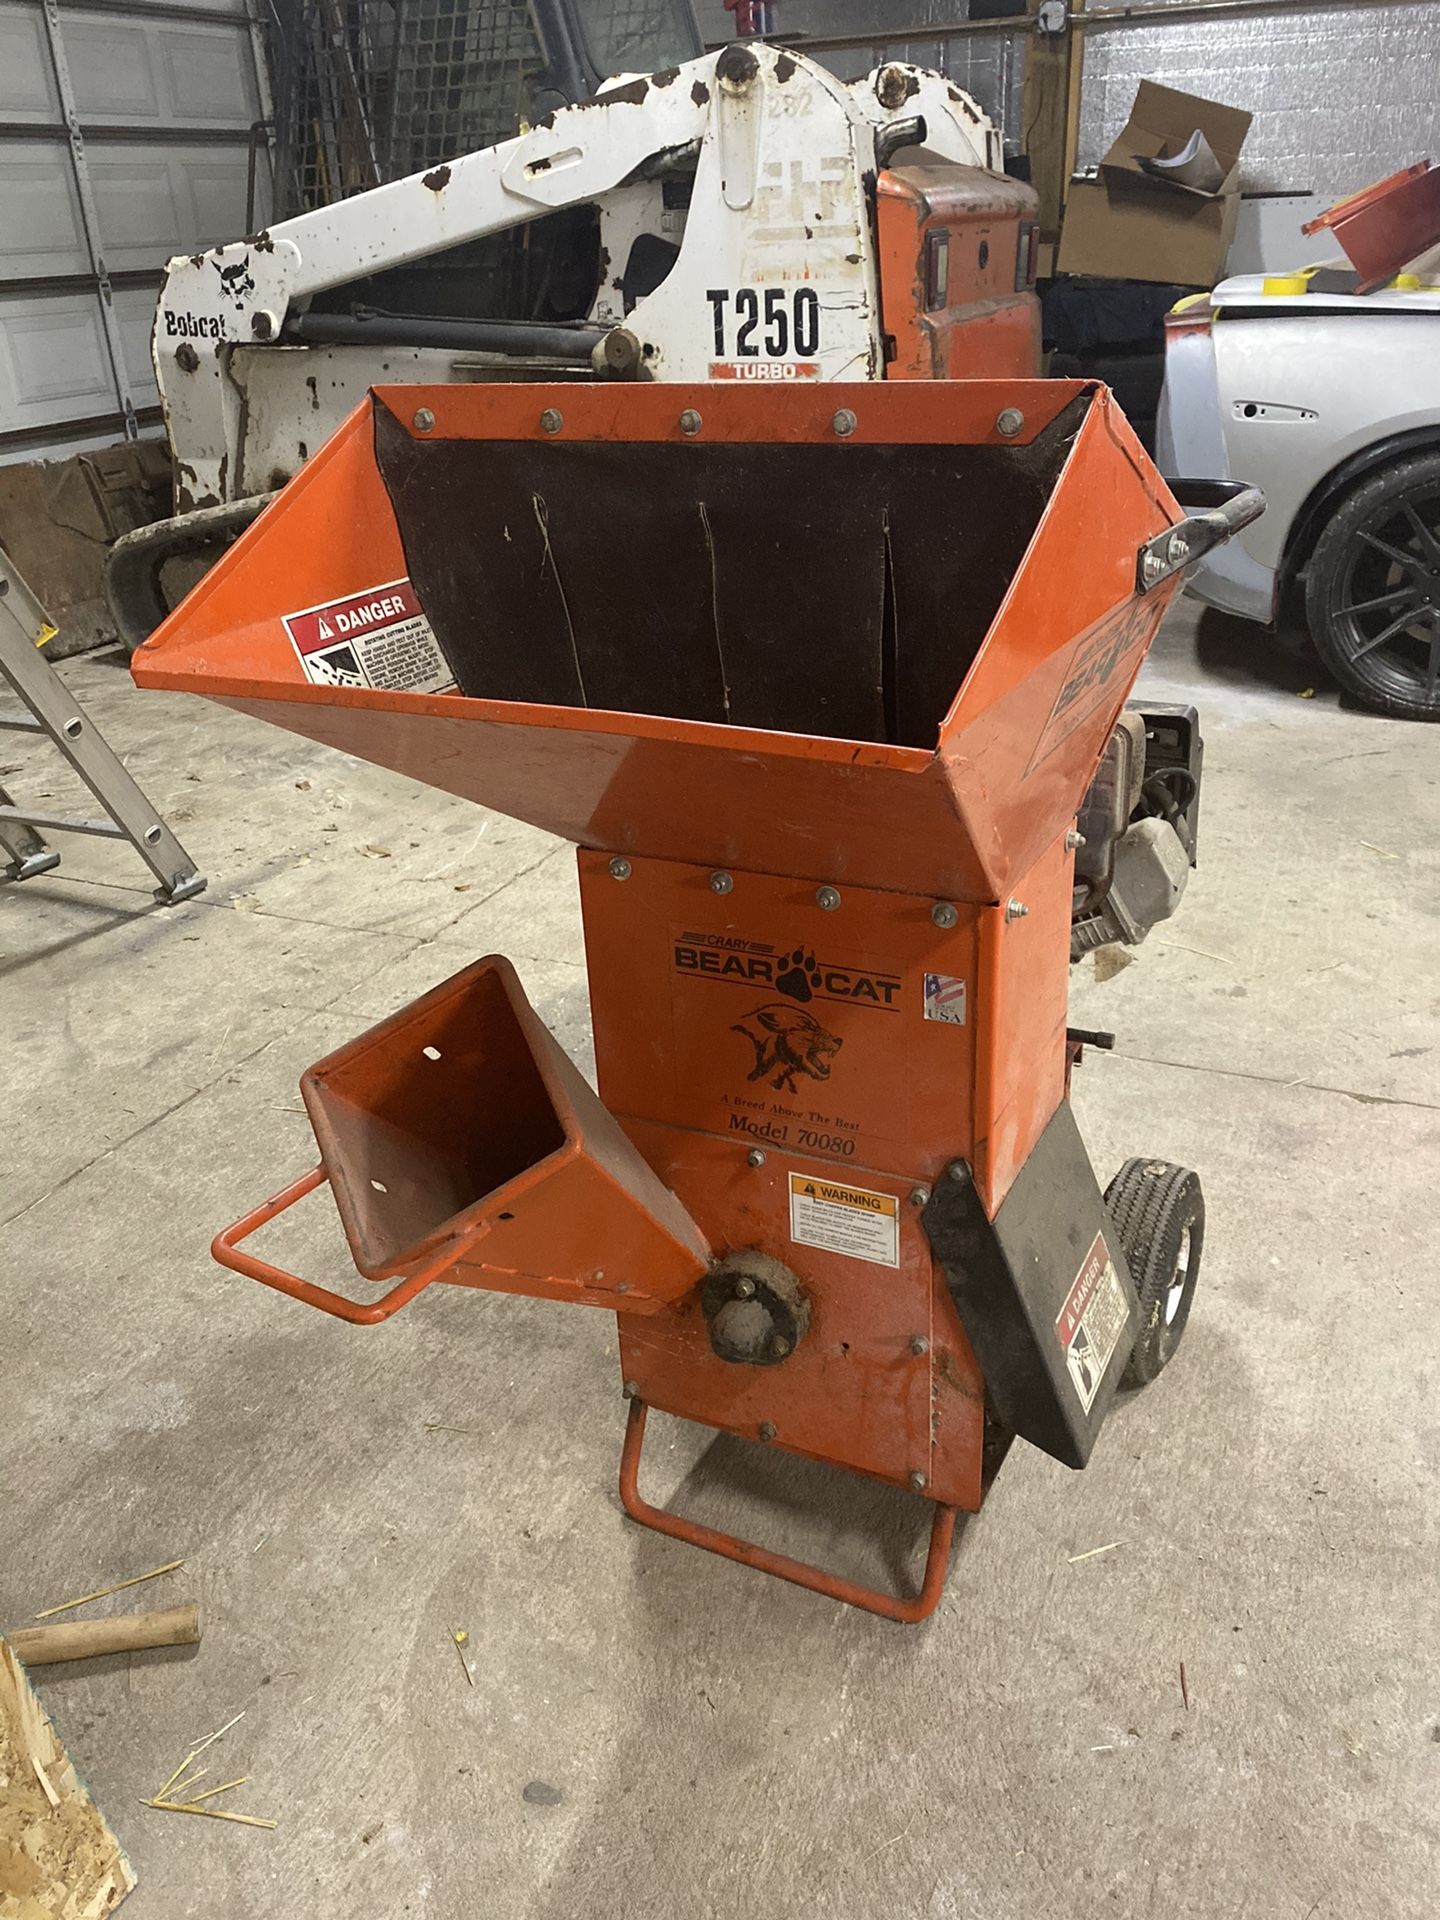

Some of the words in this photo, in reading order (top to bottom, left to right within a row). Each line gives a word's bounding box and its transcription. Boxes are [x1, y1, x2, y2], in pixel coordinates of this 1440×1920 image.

[164, 310, 227, 338] Bobcat
[706, 287, 819, 357] T250
[734, 363, 796, 379] TURBO
[335, 595, 406, 633] DANGER
[707, 934, 750, 949] CRARY
[674, 946, 773, 982] BEAR
[825, 972, 902, 1003] CAT
[928, 1009, 961, 1023] USA
[721, 1094, 729, 1103] A
[734, 1096, 765, 1111] Breed
[770, 1104, 803, 1118] Above
[808, 1112, 831, 1125] The
[836, 1117, 860, 1131] Best
[729, 1113, 788, 1141] Model
[798, 1128, 856, 1156] 70080
[820, 1186, 881, 1210] WARNING
[1072, 1256, 1101, 1315] DANGER
